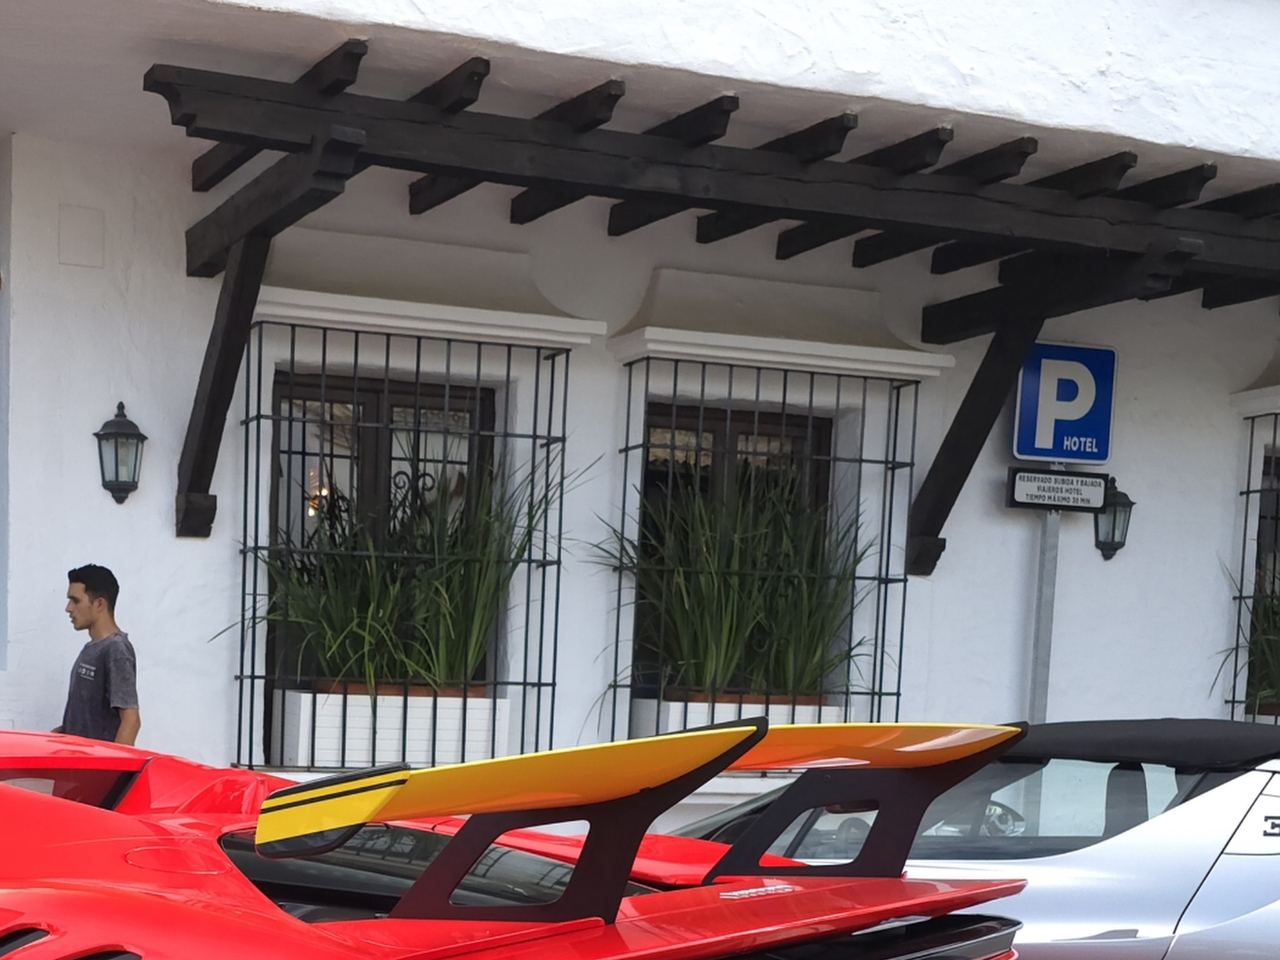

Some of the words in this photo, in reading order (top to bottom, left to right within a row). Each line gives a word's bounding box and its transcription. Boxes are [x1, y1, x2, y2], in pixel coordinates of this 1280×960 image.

[1034, 358, 1096, 449] P
[1063, 436, 1098, 453] HOTEL
[1018, 475, 1052, 484] RESERVADO
[1053, 478, 1074, 486] SUBIDA
[1080, 480, 1102, 488] BAJADA
[1037, 485, 1064, 494] VIAJEROS
[1065, 488, 1083, 496] HOTEL
[1025, 493, 1046, 502] TIEMPO
